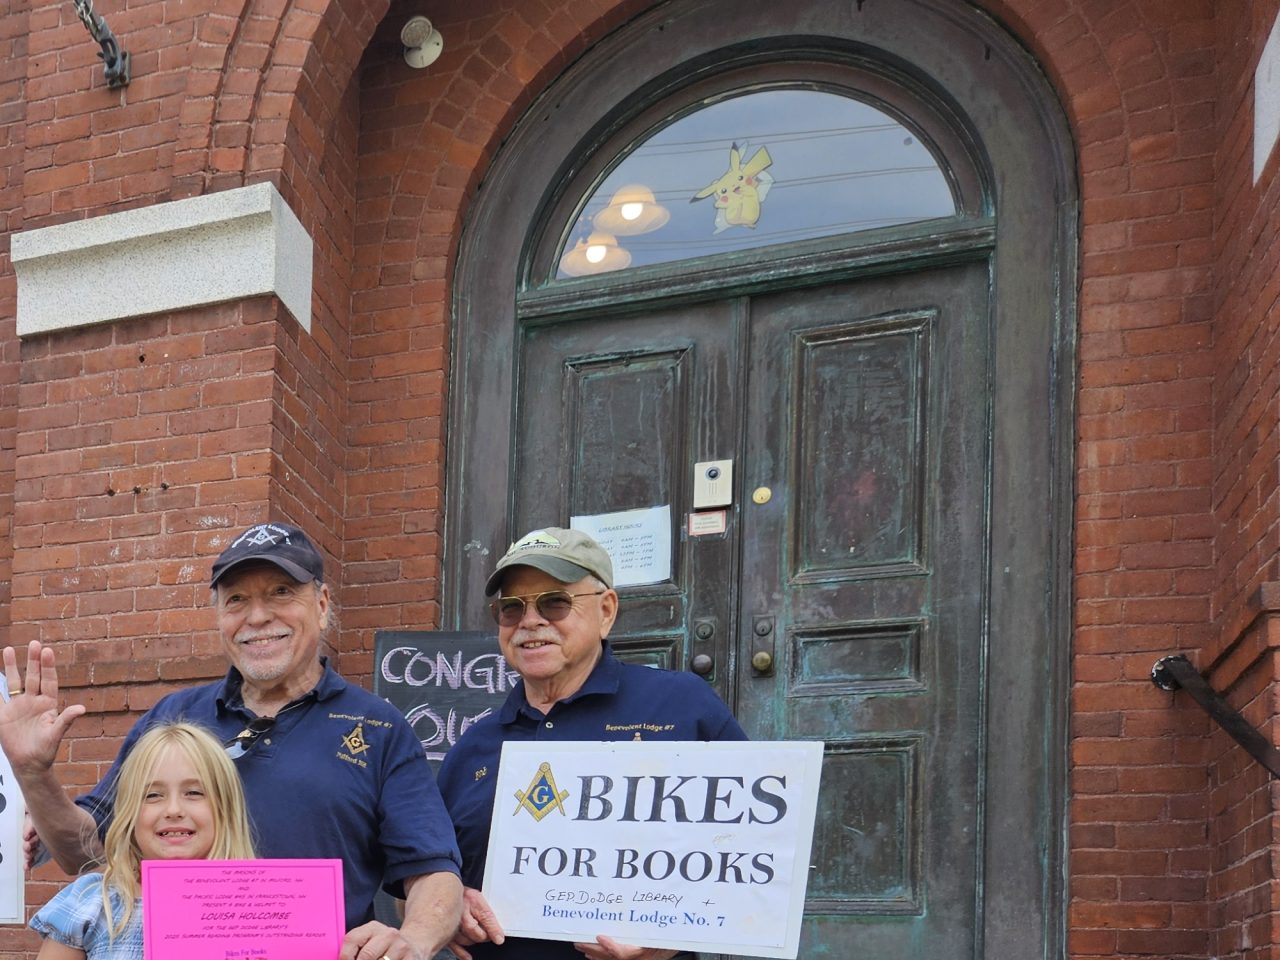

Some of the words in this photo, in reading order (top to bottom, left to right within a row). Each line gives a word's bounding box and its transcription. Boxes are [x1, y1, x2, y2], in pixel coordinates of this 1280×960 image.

[571, 774, 788, 825] BIKES
[510, 845, 598, 878] FOR
[611, 847, 775, 885] BOOKS
[632, 889, 684, 907] LIBRARY
[201, 912, 236, 921] LOUISA
[542, 904, 623, 922] Benevolent
[629, 909, 678, 927] Lodge
[682, 911, 710, 926] No.
[717, 915, 725, 927] 7
